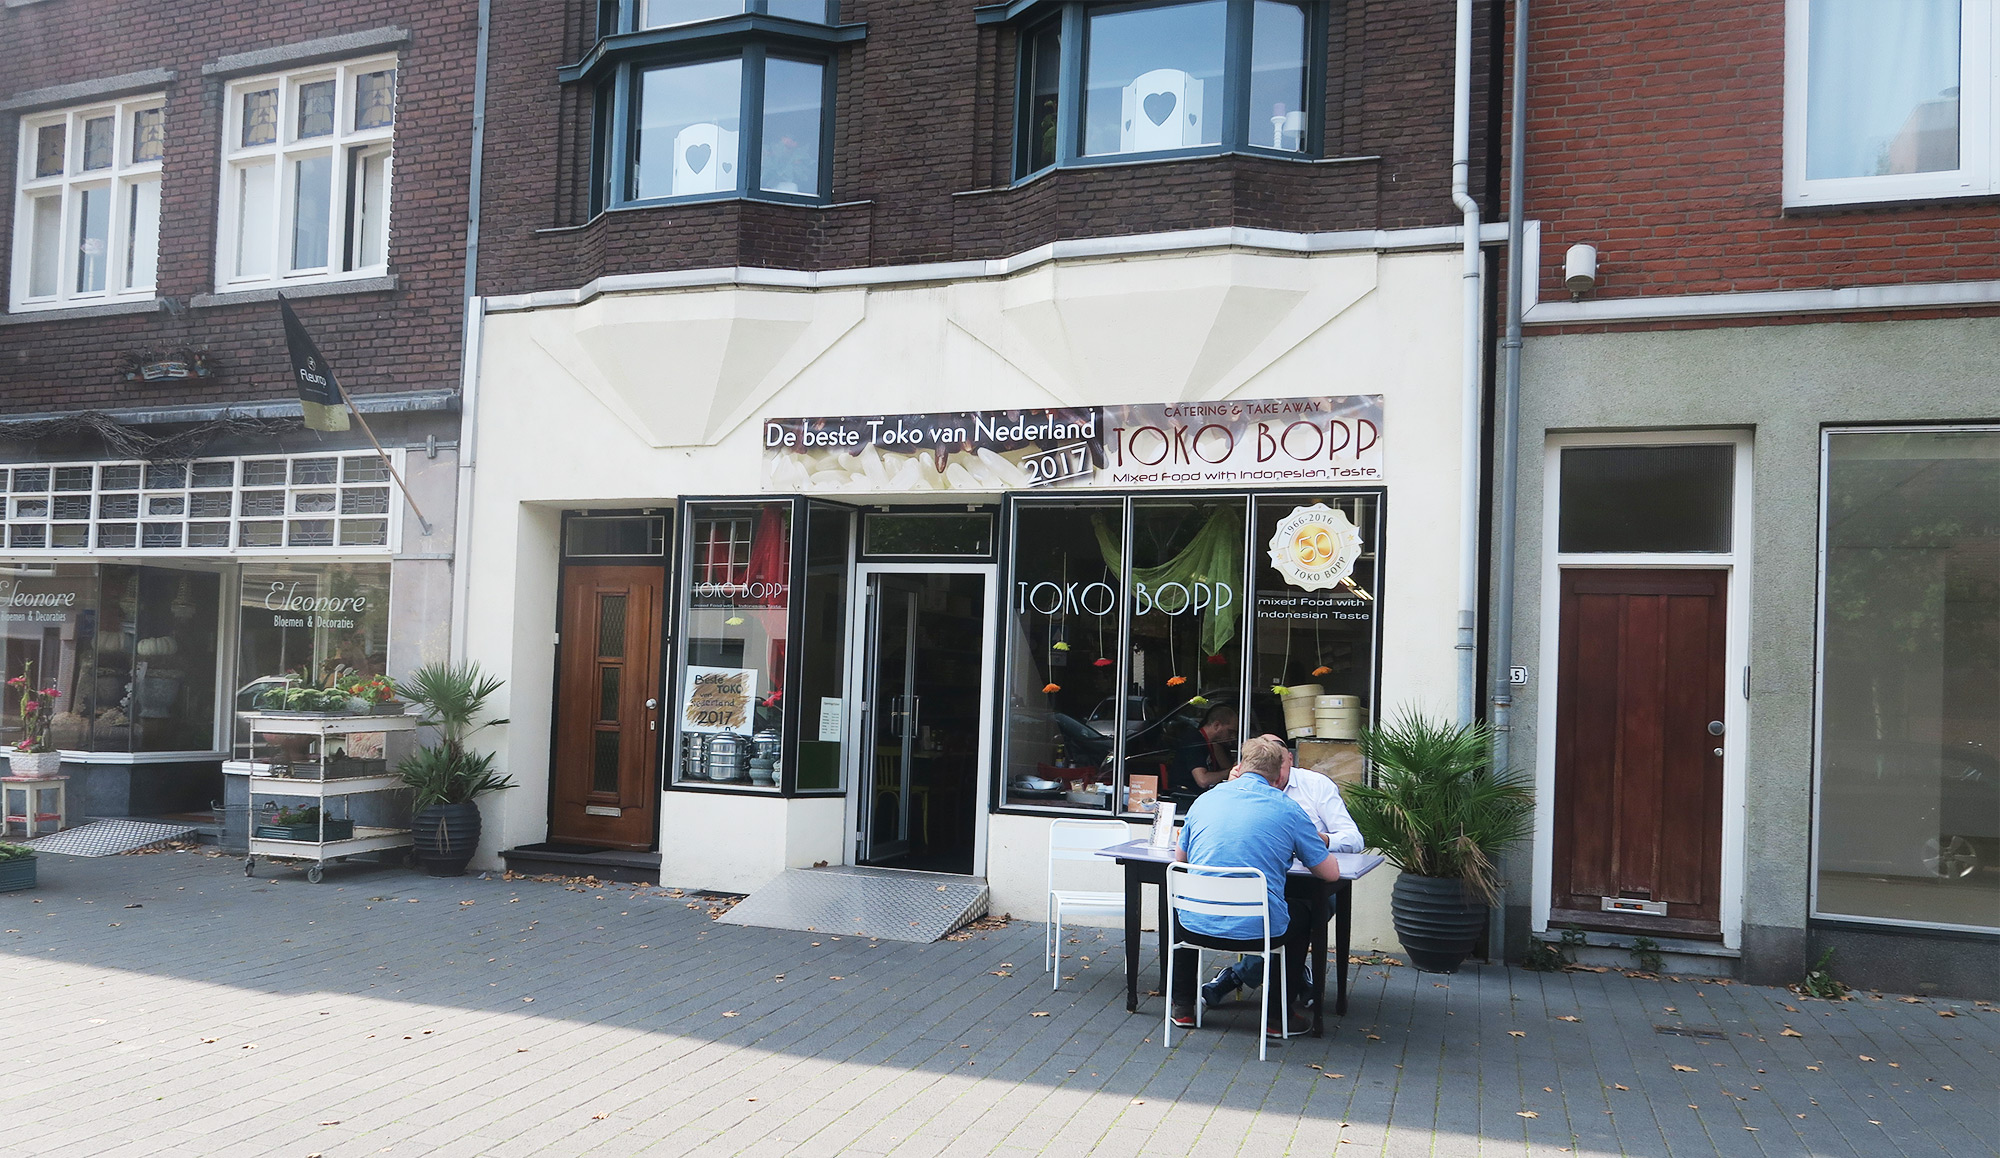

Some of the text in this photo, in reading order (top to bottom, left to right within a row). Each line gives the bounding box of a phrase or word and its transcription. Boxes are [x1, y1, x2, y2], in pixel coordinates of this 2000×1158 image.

[1164, 402, 1321, 417] CATERING & TAKE AWAY
[766, 411, 1096, 447] De beste Toko van Nederland
[1112, 418, 1378, 467] TOKO BOPP
[1024, 446, 1087, 484] 2017
[1113, 466, 1377, 483] Mixed Food with Indonesian Taste
[1284, 513, 1334, 537] 1966-2016
[1298, 531, 1334, 563] 50
[1294, 556, 1347, 581] TOKO BOPP
[265, 581, 366, 612] Eleonore
[694, 581, 783, 599] TOKO BOPP
[1017, 581, 1233, 616] TOKO BOPP
[1258, 597, 1365, 607] mixed Food with
[28, 610, 33, 622] &
[35, 610, 67, 622] Decoraties
[273, 615, 354, 629] Bloemen & Decoraties
[1257, 610, 1370, 620] Indonesian Taste
[694, 674, 724, 685] Beste
[717, 684, 744, 694] TOKO
[697, 710, 733, 725] 2017
